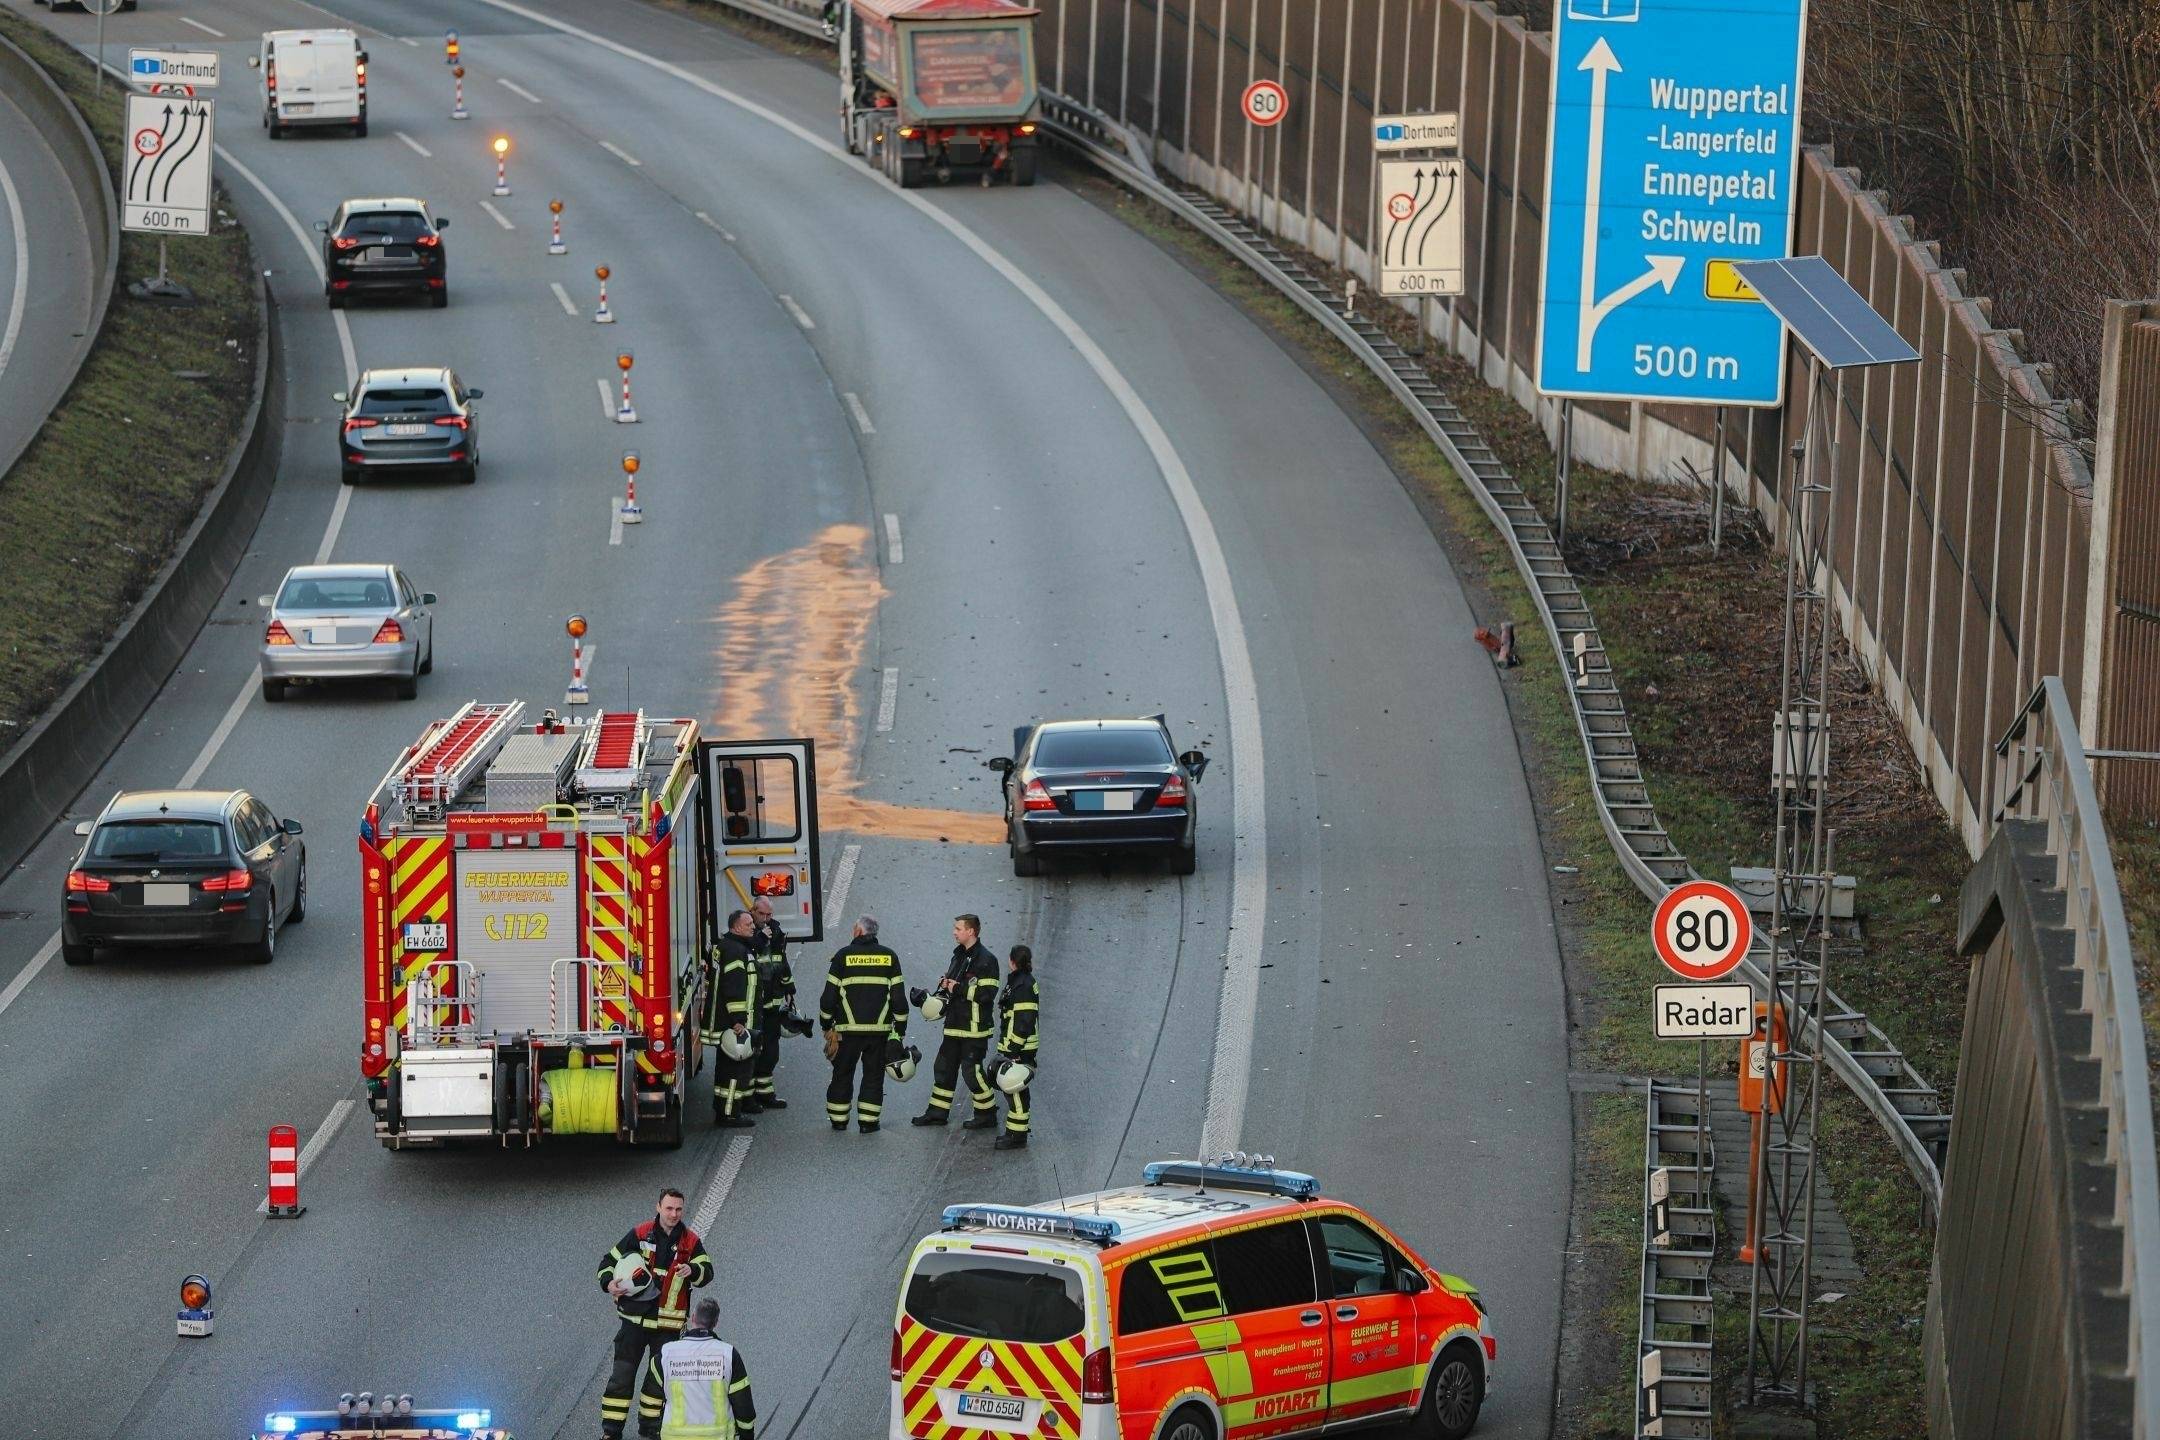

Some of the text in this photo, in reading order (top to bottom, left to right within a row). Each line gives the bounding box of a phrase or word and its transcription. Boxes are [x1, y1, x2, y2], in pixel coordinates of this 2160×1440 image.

[143, 59, 216, 78] 1 Dortmund
[1253, 93, 1277, 112] 80
[1650, 78, 1788, 119] Wuppertal
[1387, 122, 1456, 140] 1 Dortmund
[1647, 124, 1777, 158] -Langerfeld
[1643, 163, 1776, 206] Ennepetal
[142, 211, 189, 228] 600 m
[1641, 208, 1761, 245] Schwelm
[1399, 275, 1445, 290] 600 m
[1634, 344, 1738, 380] 500 m
[450, 815, 544, 825] www.feuerwehr-wuppertal.de
[465, 871, 569, 888] FEUERWEHR
[479, 889, 554, 903] WUPPERTAL
[423, 926, 431, 936] W
[503, 912, 549, 940] 112
[1675, 909, 1729, 952] 80
[407, 936, 445, 947] FW 6602
[1665, 1001, 1747, 1026] Radar
[986, 1212, 1057, 1234] NOTARZT
[1351, 1322, 1389, 1339] FEUERWEHR
[1254, 1342, 1296, 1358] Rettungsdienst
[1301, 1337, 1323, 1349] Notarzt
[1313, 1347, 1323, 1357] 112
[669, 1360, 722, 1369] Feuerwehr Wuppertal
[1273, 1360, 1323, 1376] Krankentransport
[966, 1398, 1021, 1416] W RD 6504
[1254, 1389, 1320, 1418] NOTARZT
